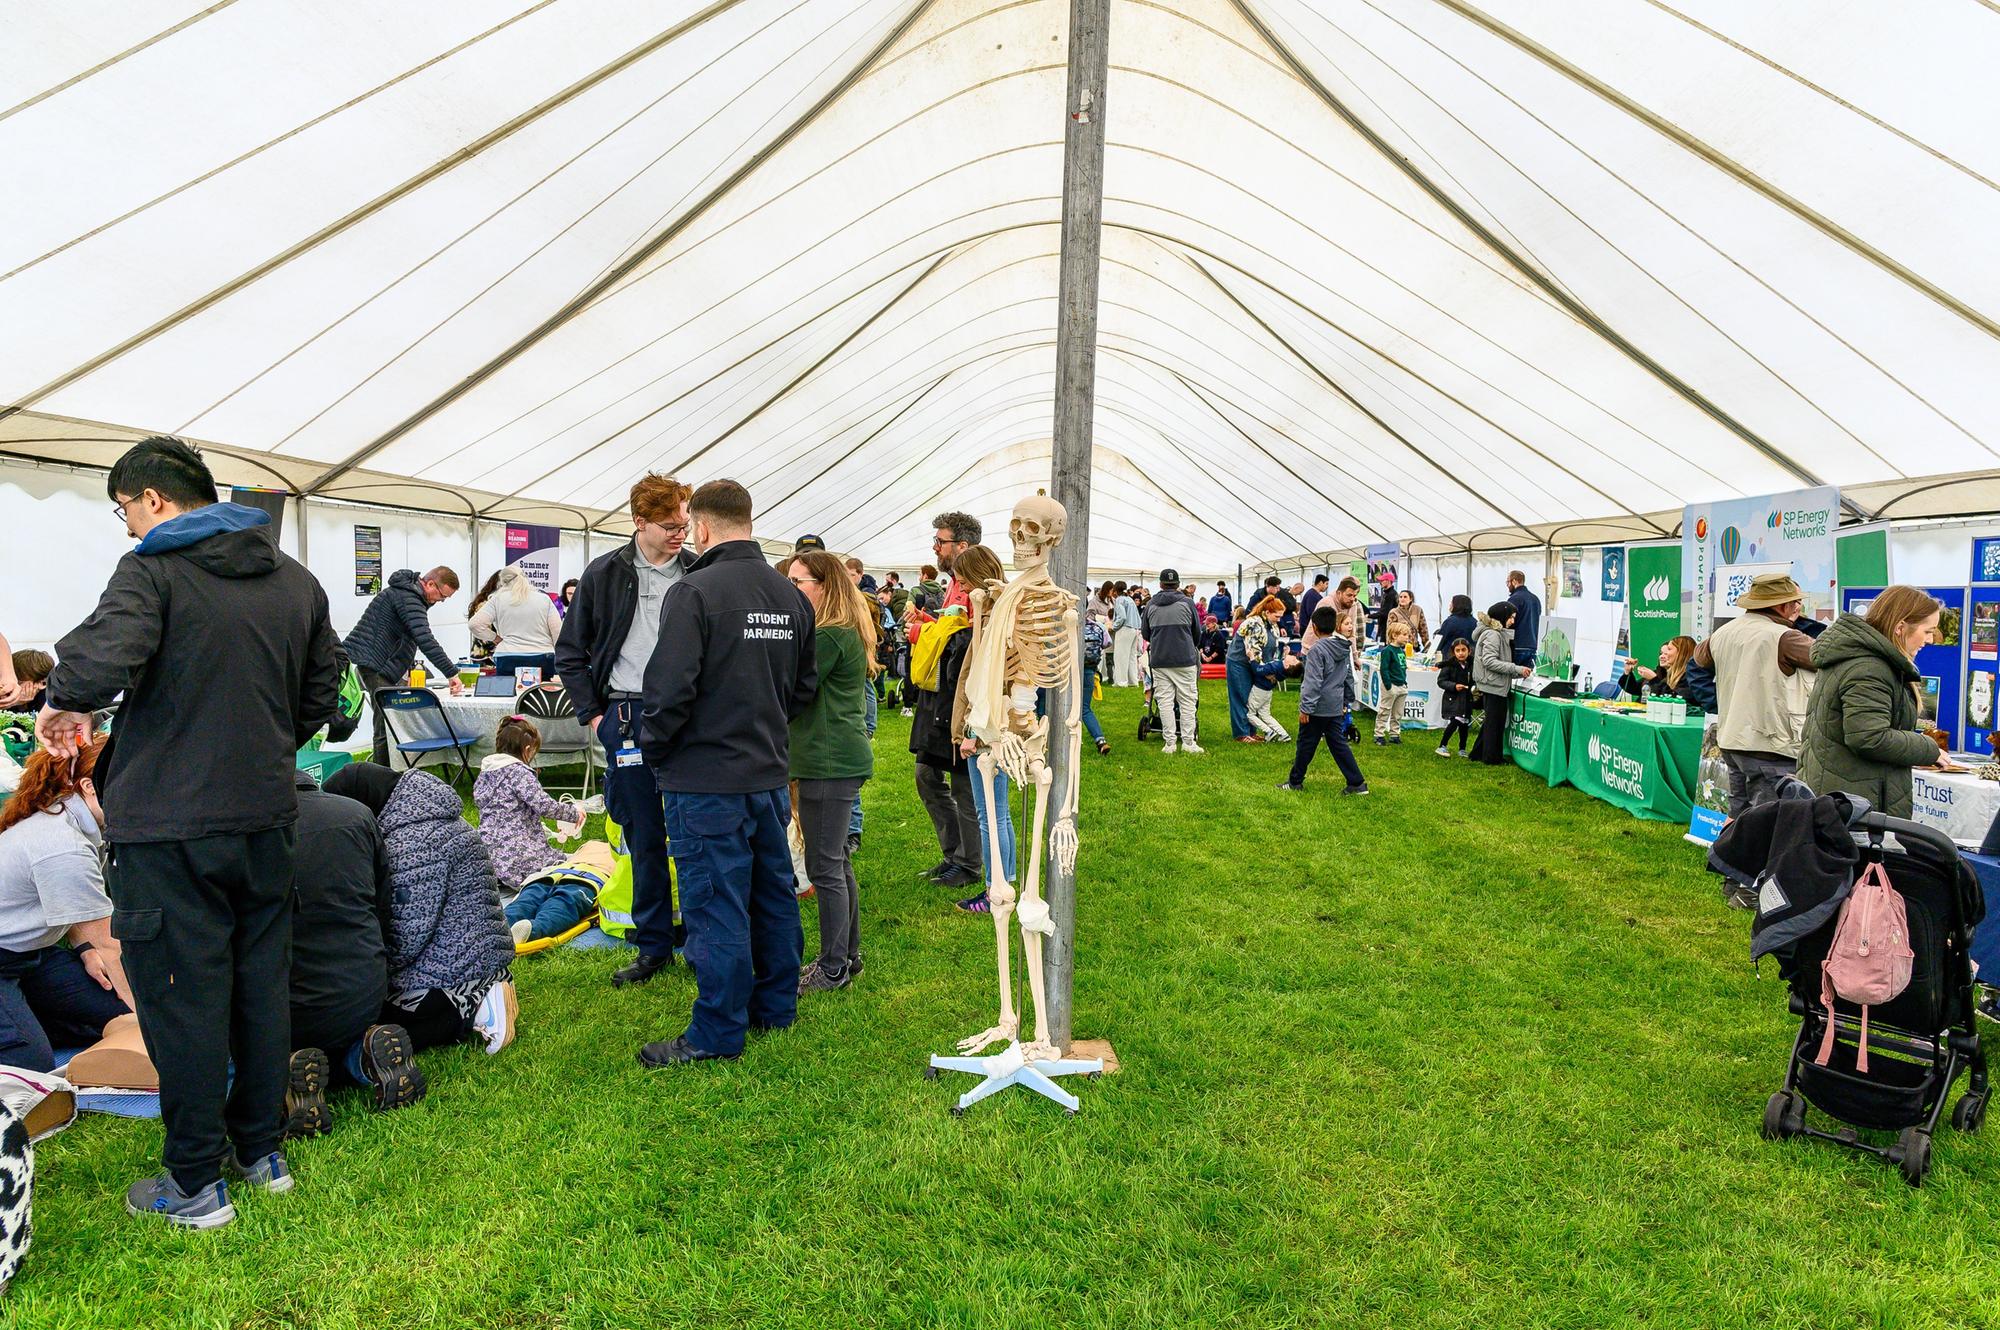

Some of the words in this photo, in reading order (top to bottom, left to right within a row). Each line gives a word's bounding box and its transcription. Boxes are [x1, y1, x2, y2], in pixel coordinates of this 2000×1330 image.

[1783, 511, 1796, 525] SP
[1797, 508, 1831, 524] Energy
[1783, 524, 1826, 540] Networks
[519, 560, 550, 569] Summer
[524, 569, 550, 581] ading
[1633, 609, 1679, 619] ScottishPower
[1403, 708, 1425, 718] RTH
[1519, 714, 1543, 740] Energy
[1508, 730, 1538, 755] Networks
[1600, 743, 1613, 764] SP
[1612, 748, 1643, 782] Energy
[1601, 764, 1645, 800] Networks
[1914, 777, 1954, 805] Trust
[1925, 805, 1949, 819] future
